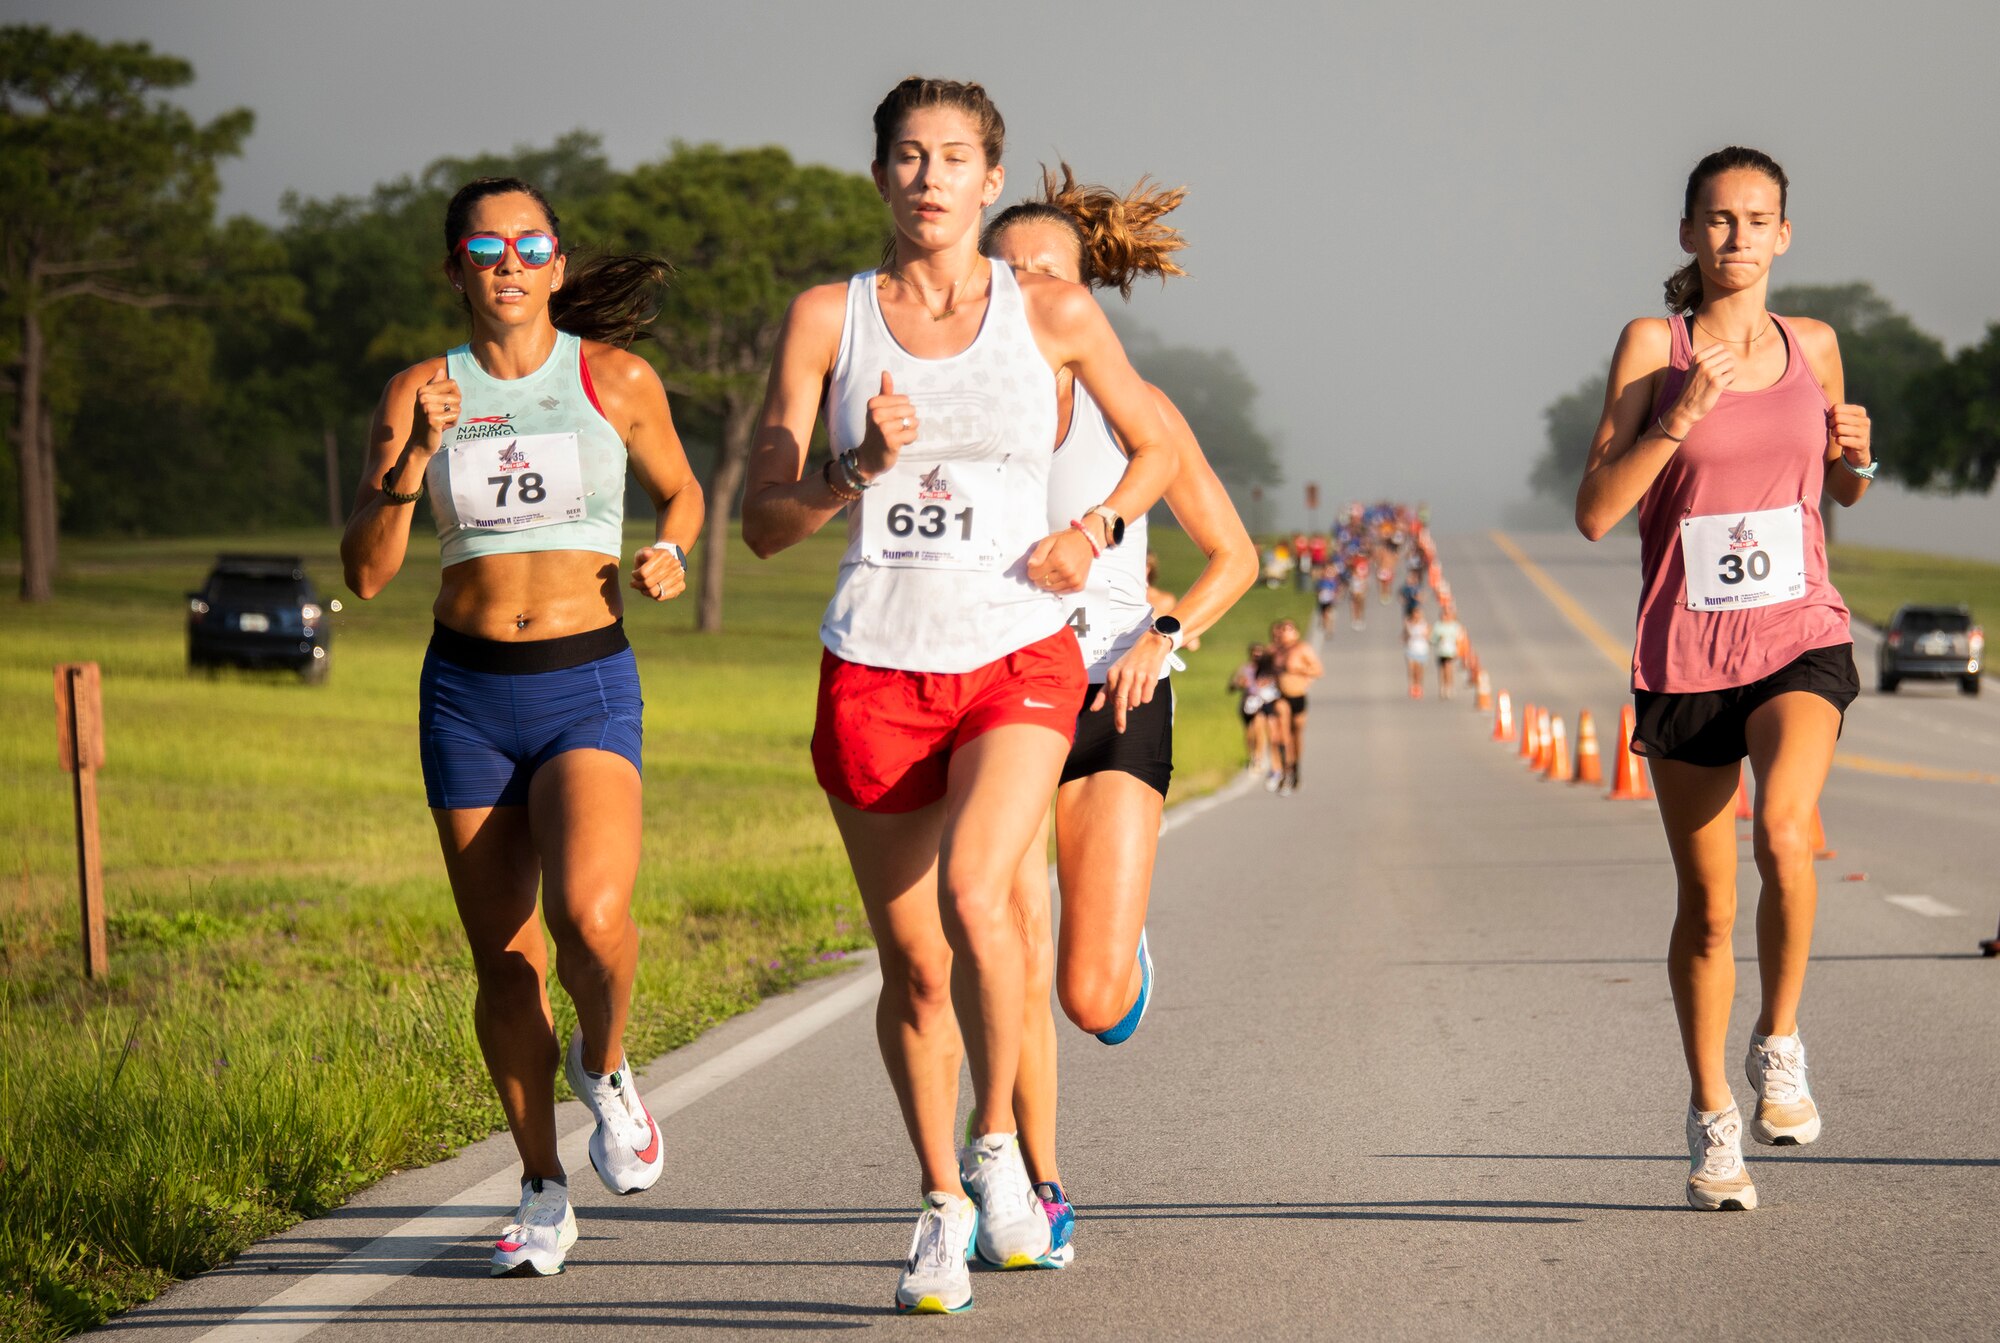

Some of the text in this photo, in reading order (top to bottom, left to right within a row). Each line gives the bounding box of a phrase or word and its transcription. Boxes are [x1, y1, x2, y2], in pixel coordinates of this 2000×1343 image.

[456, 430, 511, 441] RUNNING
[512, 451, 524, 462] 35
[487, 472, 547, 508] 78
[934, 479, 947, 491] 35
[886, 503, 974, 541] 631
[1742, 529, 1754, 541] 35
[1718, 550, 1771, 585] 30
